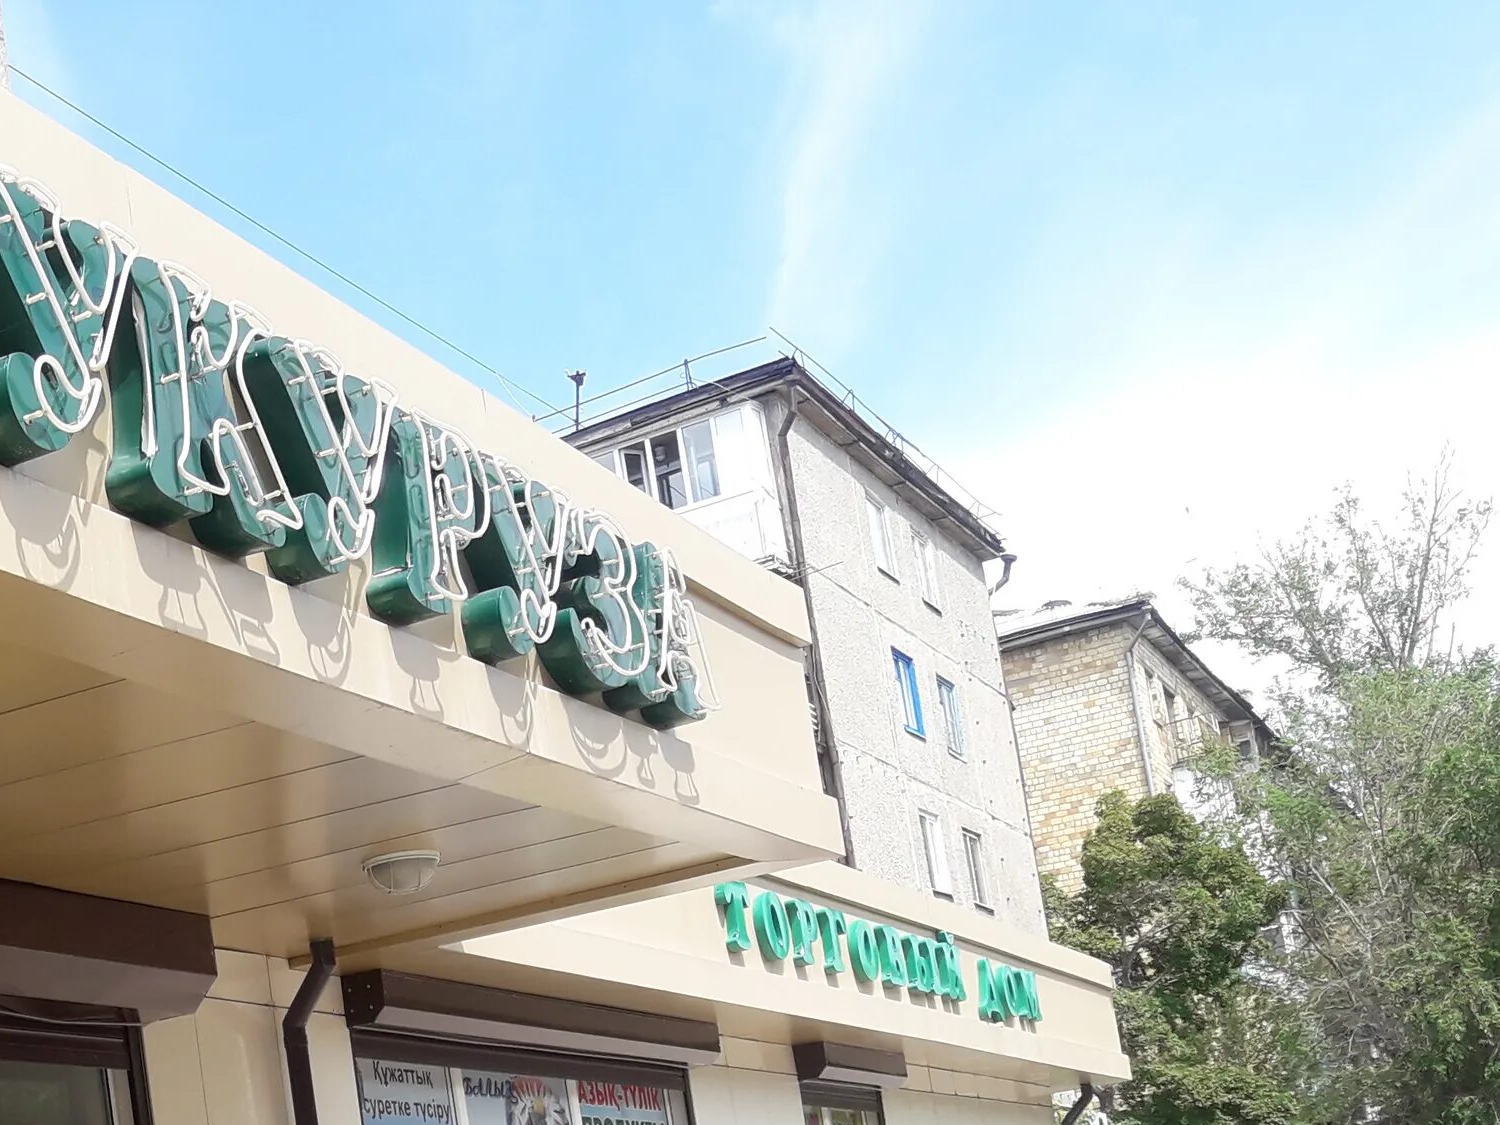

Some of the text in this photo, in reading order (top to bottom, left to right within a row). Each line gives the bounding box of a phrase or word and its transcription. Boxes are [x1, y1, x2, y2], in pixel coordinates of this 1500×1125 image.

[714, 881, 1043, 1023] ТОРГОВЫЙ ДОМ
[372, 1060, 434, 1088] Құжаттық
[363, 1098, 450, 1124] суретке түсіру
